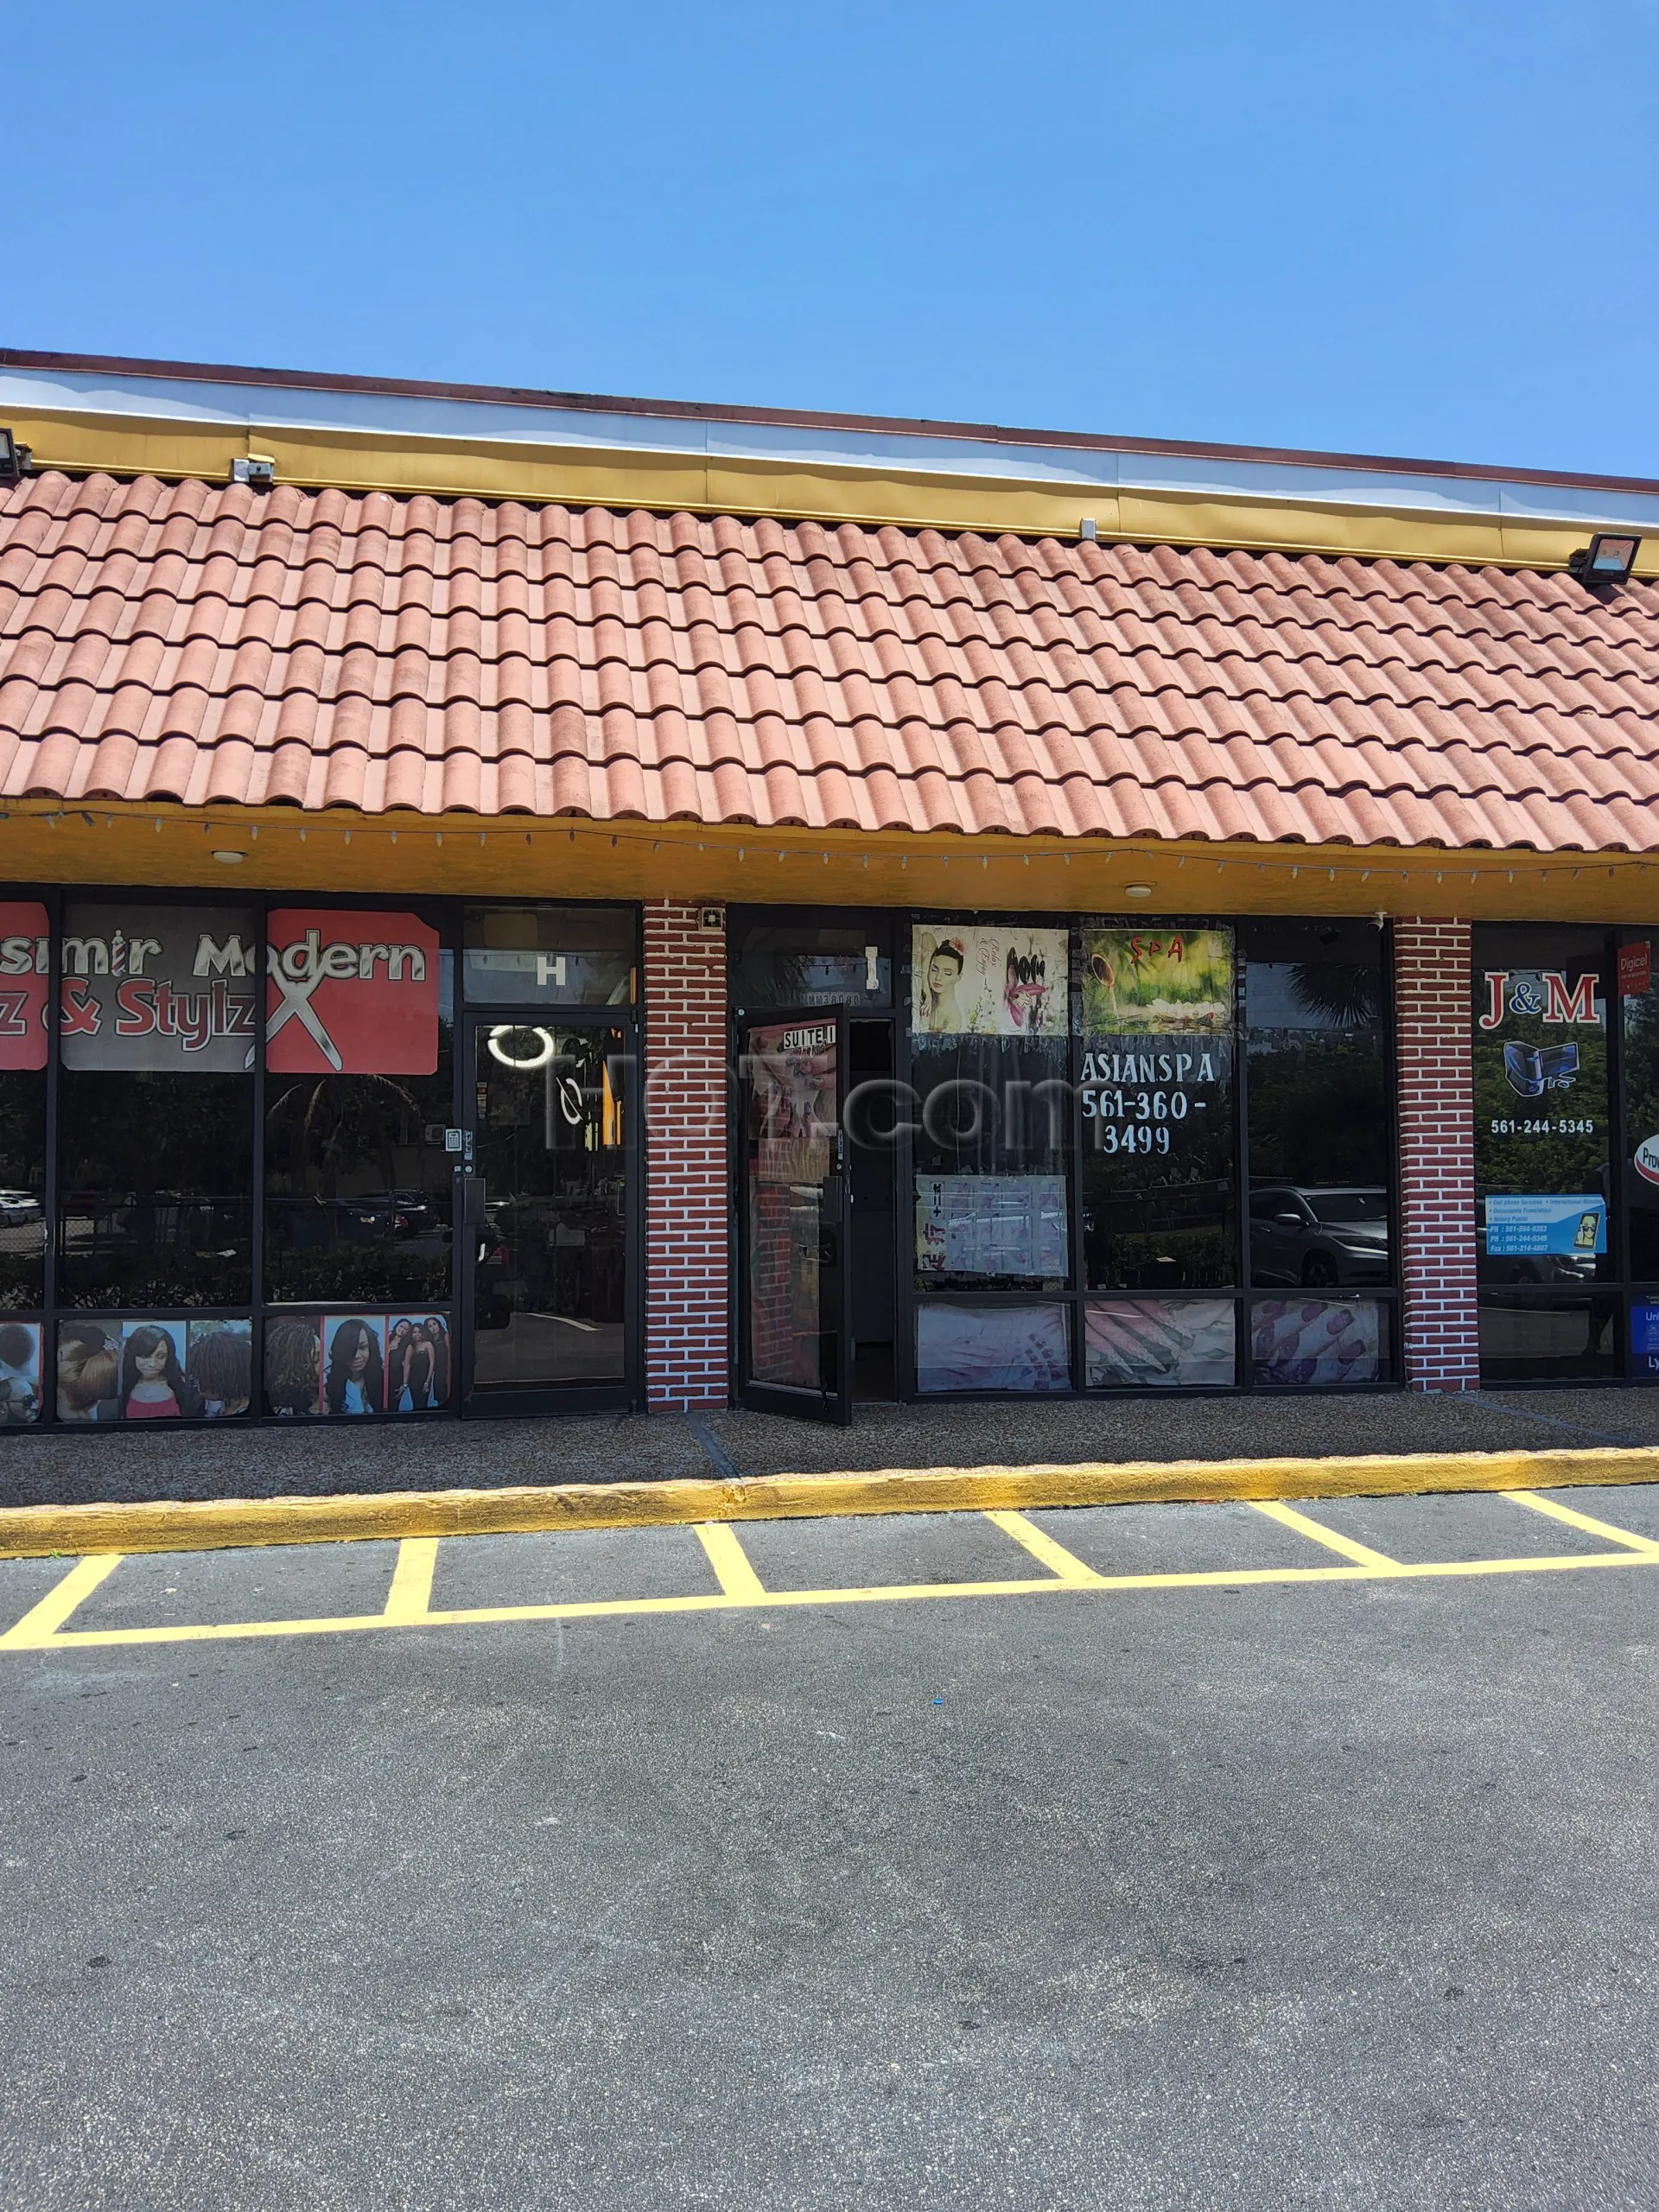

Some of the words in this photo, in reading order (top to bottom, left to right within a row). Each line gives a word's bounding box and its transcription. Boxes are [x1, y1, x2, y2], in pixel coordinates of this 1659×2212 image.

[976, 948, 989, 976] Enjoy
[988, 937, 1001, 967] Relax
[1130, 933, 1185, 964] SPA
[1620, 952, 1648, 972] Digicel
[1478, 971, 1600, 1030] J&M
[785, 1028, 823, 1048] SUITE
[1103, 1124, 1171, 1154] 3499
[1491, 1119, 1594, 1134] 561-244-5345
